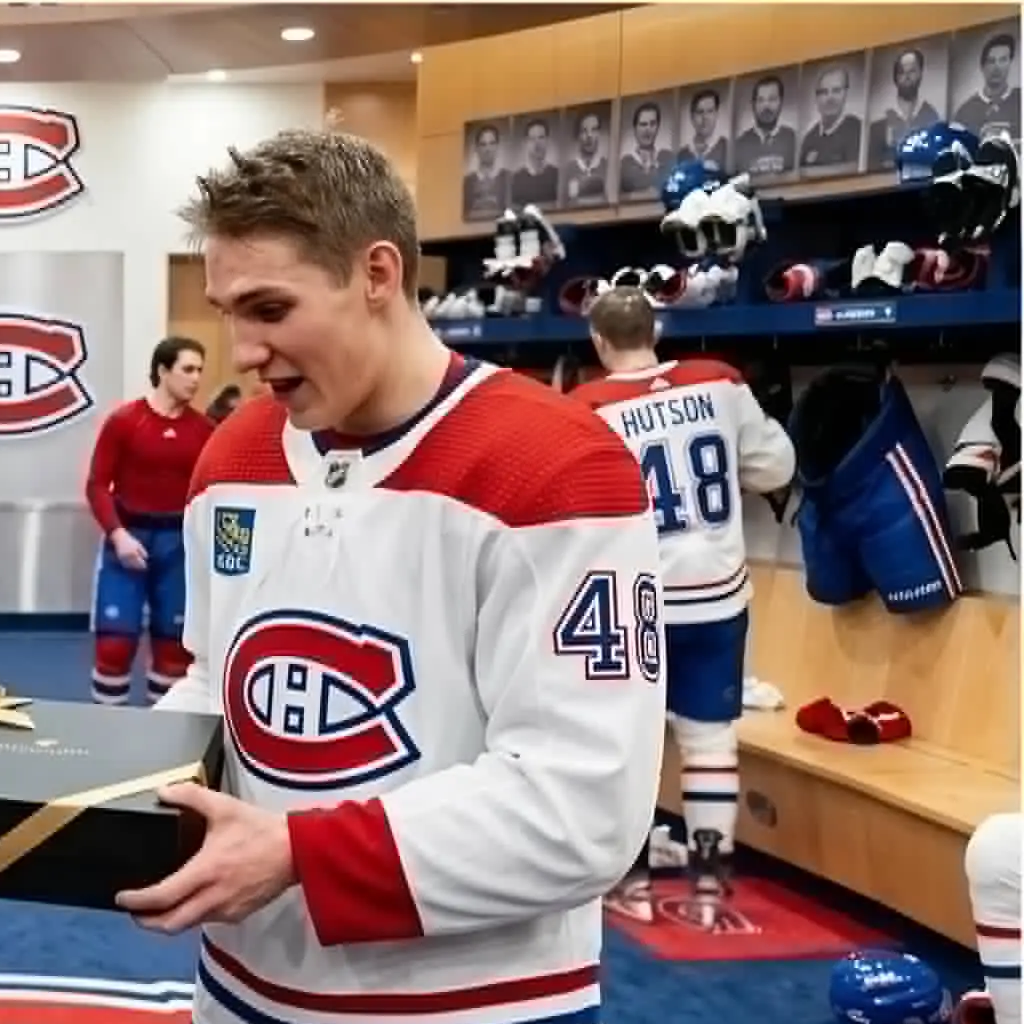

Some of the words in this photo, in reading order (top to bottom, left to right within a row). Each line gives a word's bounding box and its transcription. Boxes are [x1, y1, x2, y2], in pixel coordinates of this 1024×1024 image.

[621, 392, 715, 438] HUTSON
[640, 438, 733, 535] 48
[553, 569, 660, 683] 48
